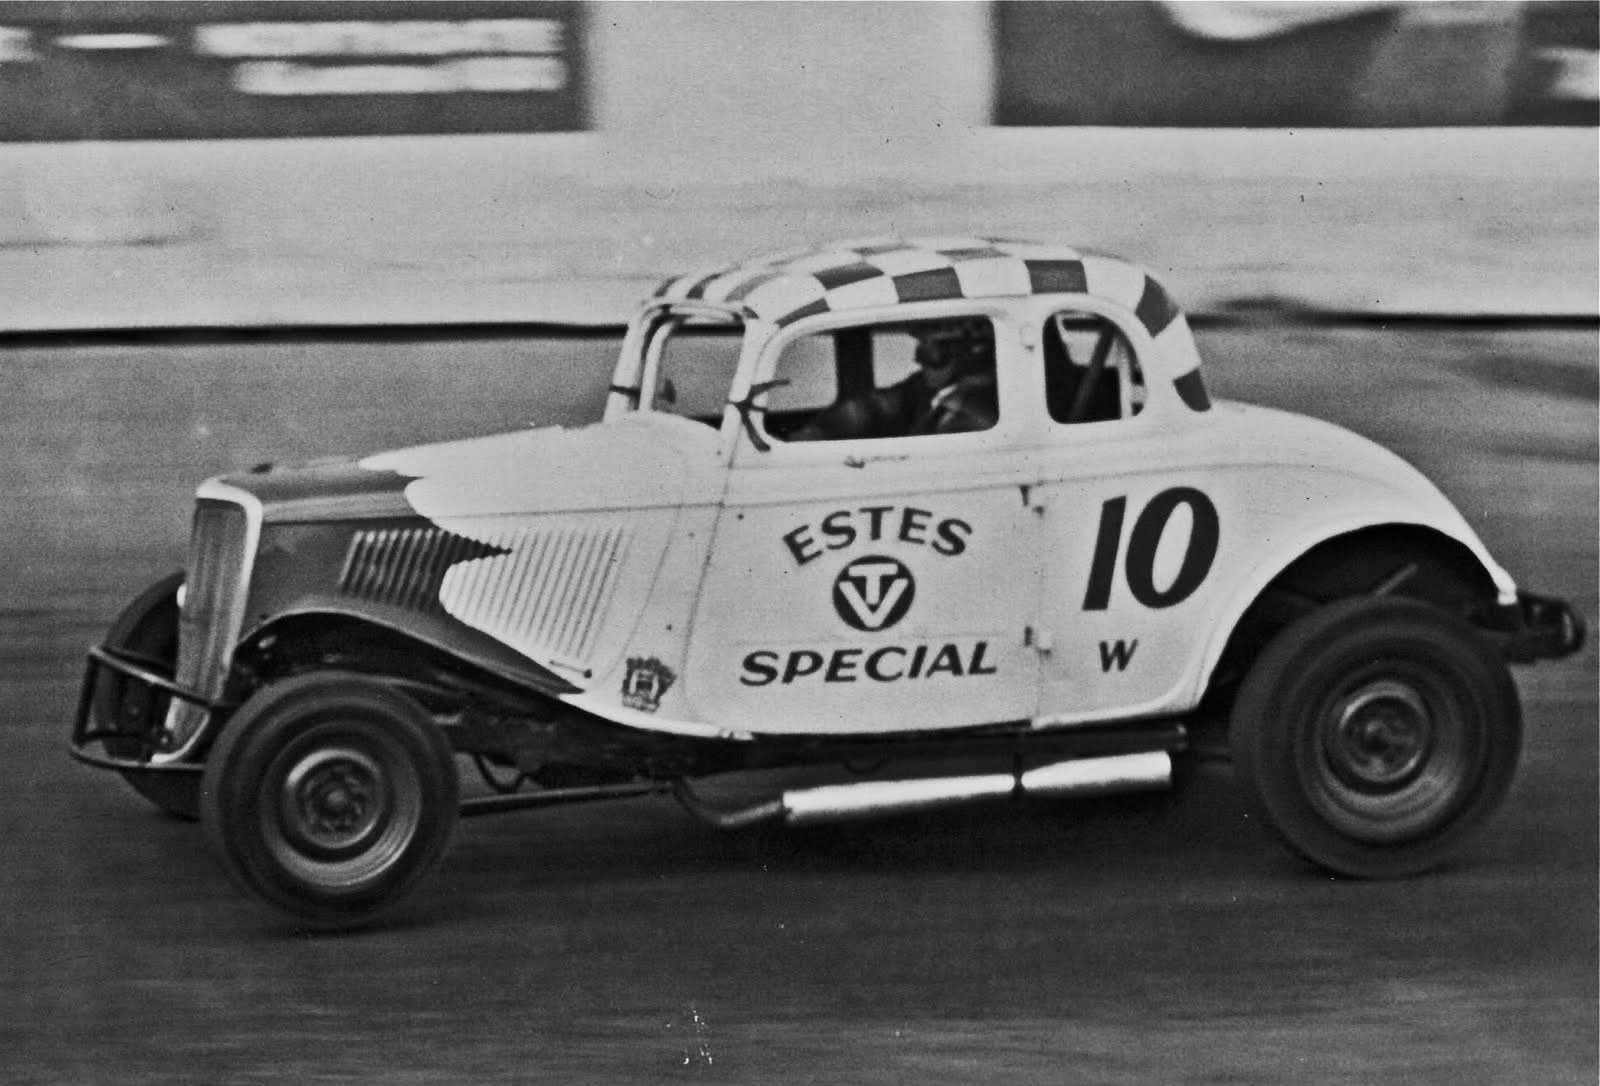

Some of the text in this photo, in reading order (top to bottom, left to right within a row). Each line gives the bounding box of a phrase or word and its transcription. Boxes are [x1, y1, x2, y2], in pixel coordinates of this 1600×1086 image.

[783, 506, 973, 565] ESTES
[1082, 486, 1220, 611] 10
[739, 641, 998, 687] SPECIAL
[1098, 638, 1138, 673] W
